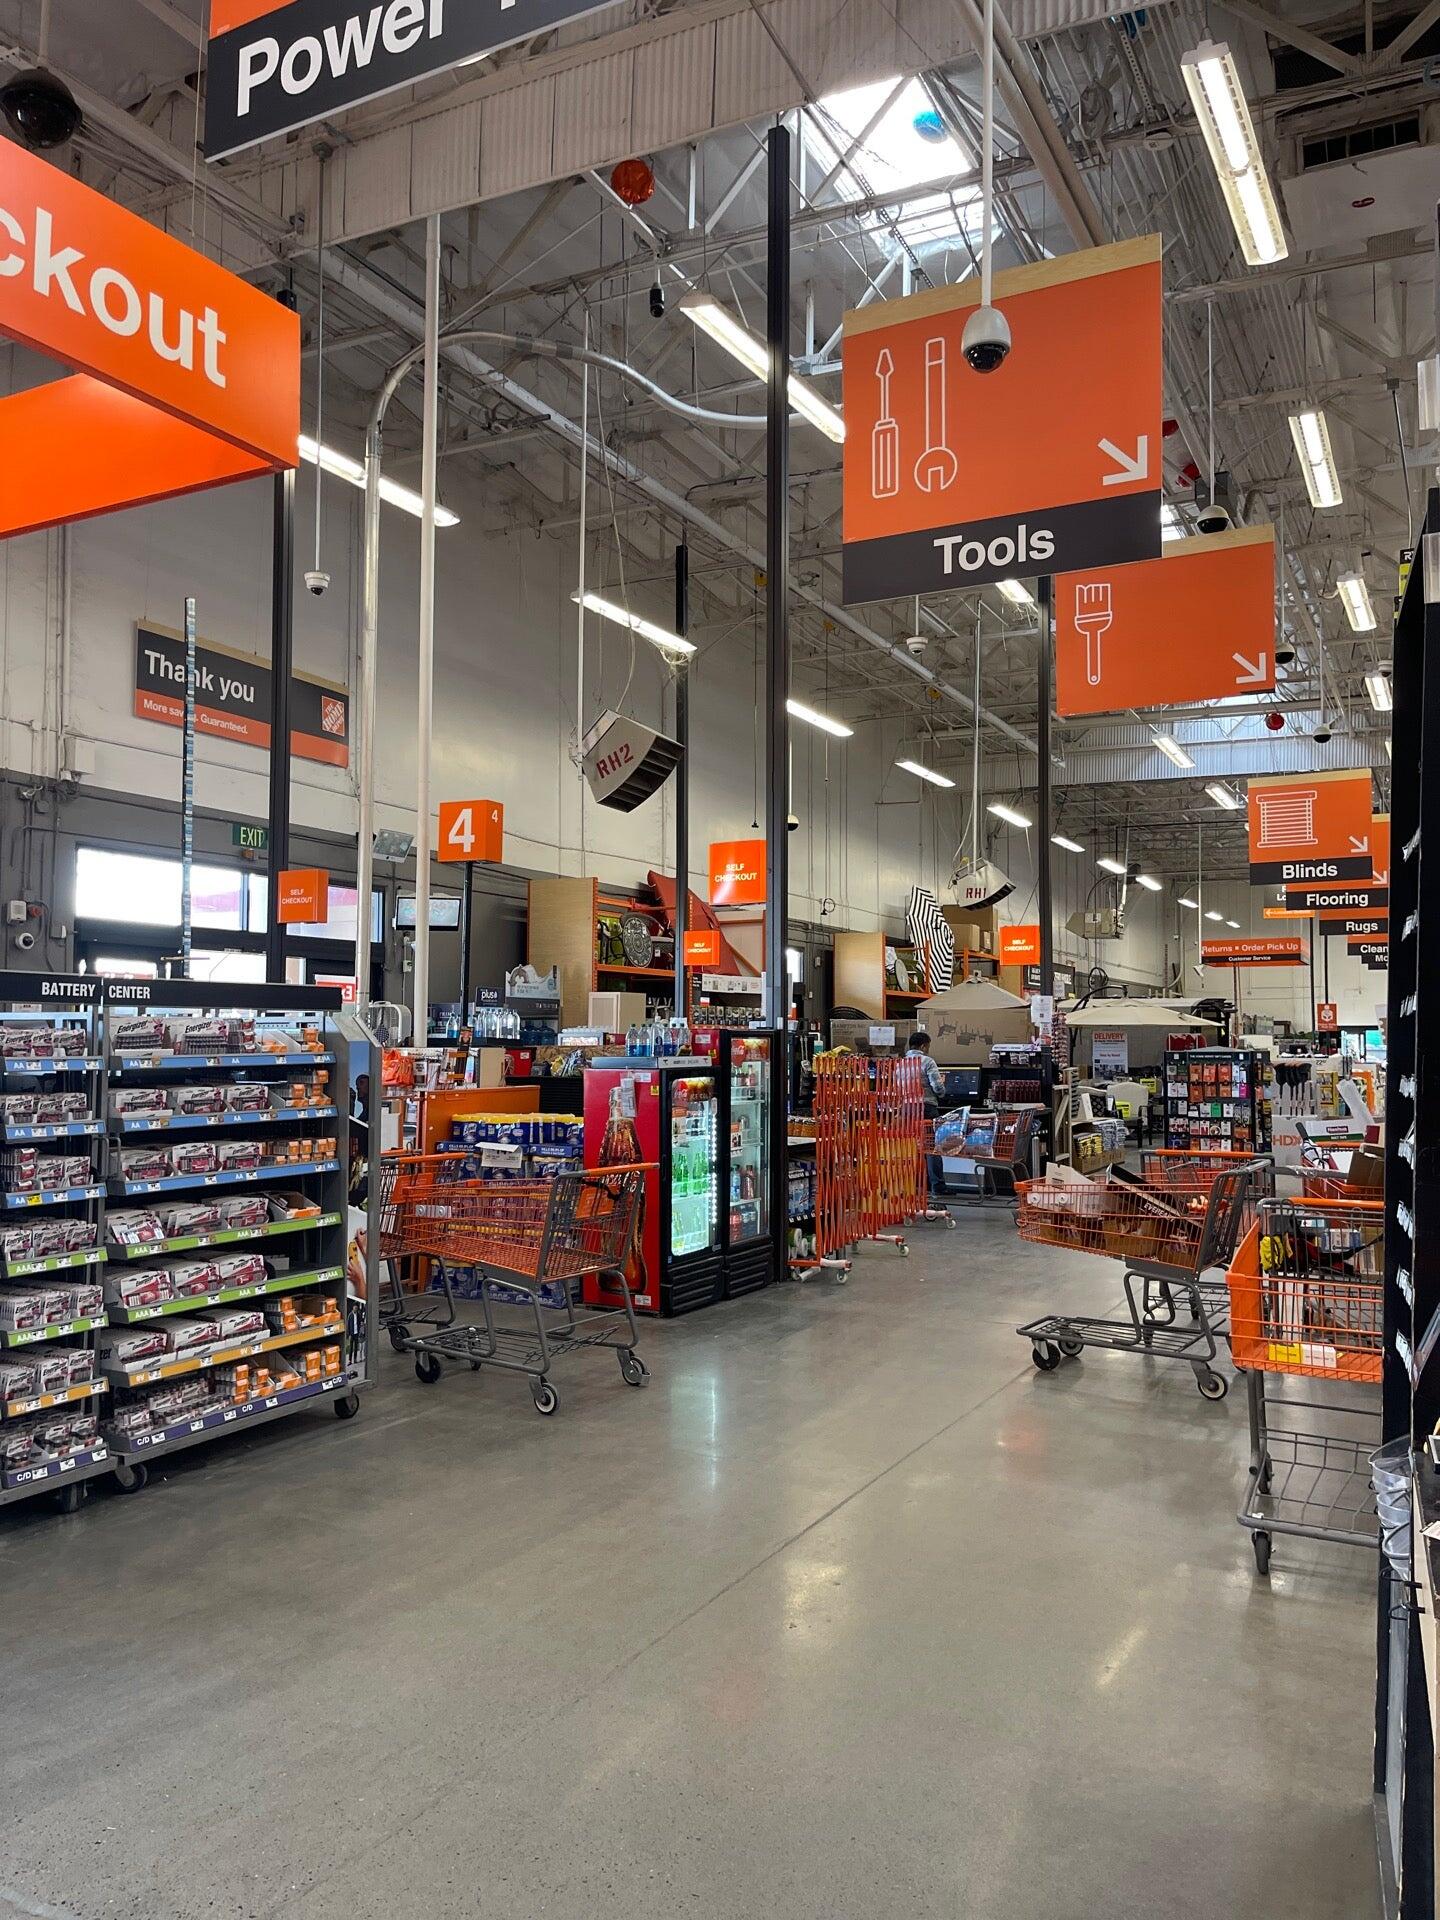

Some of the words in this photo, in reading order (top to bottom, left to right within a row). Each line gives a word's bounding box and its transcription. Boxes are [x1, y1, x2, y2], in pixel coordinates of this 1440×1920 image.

[934, 523, 1056, 575] Tools
[144, 649, 214, 692] Thank
[219, 675, 256, 703] you
[143, 698, 168, 714] More
[200, 713, 249, 735] Guaranteed.
[322, 701, 344, 731] HOME
[596, 743, 635, 779] RH2
[491, 809, 499, 823] 4
[240, 826, 264, 847] EXIT
[447, 808, 475, 853] 4
[725, 863, 745, 872] SELF
[1282, 862, 1338, 879] Blinds
[714, 872, 757, 882] CHECKOUT
[290, 888, 305, 897] SELF
[281, 895, 313, 906] CHECKOUT
[1306, 892, 1369, 908] Flooring
[1345, 921, 1379, 933] Rugs
[1201, 945, 1233, 953] Returns
[1241, 944, 1265, 952] Order
[1266, 943, 1285, 951] Pick
[1286, 942, 1299, 951] Up
[41, 982, 96, 997] BATTERY
[108, 985, 151, 1000] CENTER
[117, 1020, 149, 1034] Energizer
[184, 1020, 212, 1034] Energizer
[14, 1129, 25, 1137] AA
[1272, 1134, 1301, 1146] HDX
[15, 1196, 26, 1204] AA
[134, 1245, 148, 1254] AAA
[16, 1264, 33, 1273] AAA
[135, 1308, 149, 1318] AAA
[332, 1375, 343, 1384] C/D
[241, 1403, 253, 1413] C/D
[136, 1436, 150, 1446] C/D
[17, 1471, 32, 1482] C/D
